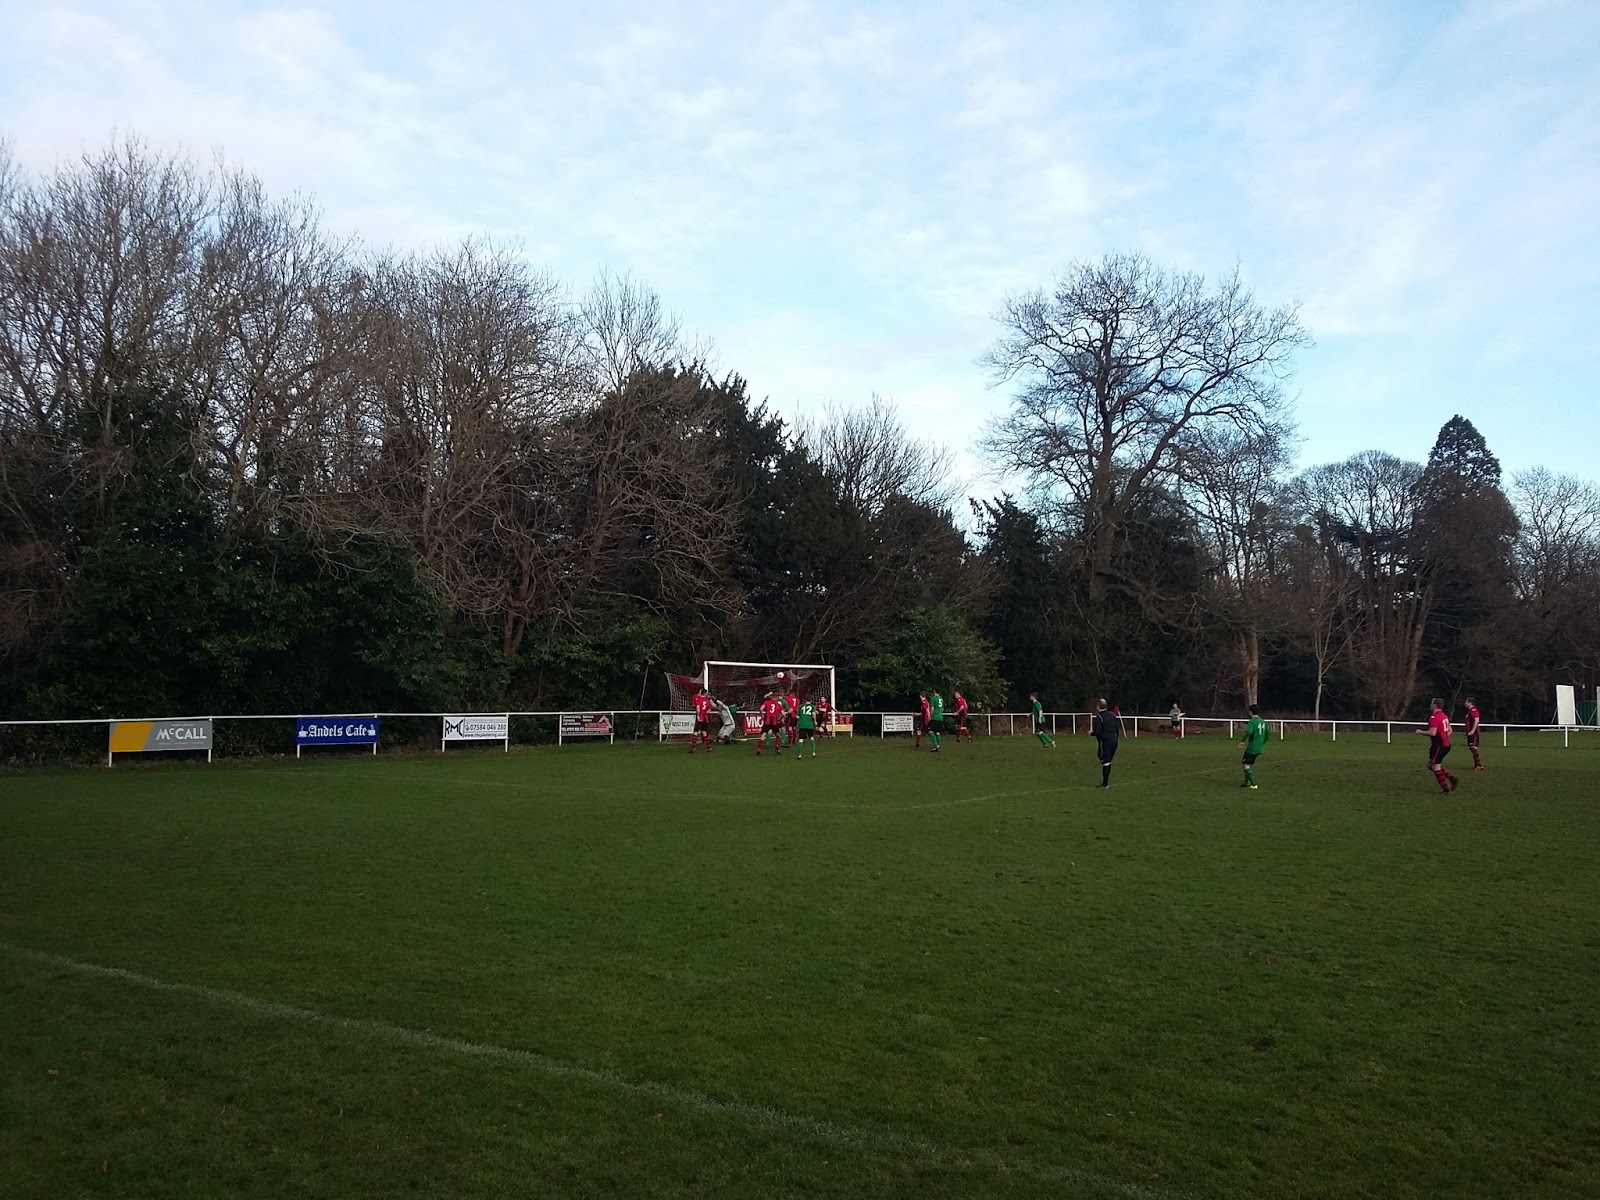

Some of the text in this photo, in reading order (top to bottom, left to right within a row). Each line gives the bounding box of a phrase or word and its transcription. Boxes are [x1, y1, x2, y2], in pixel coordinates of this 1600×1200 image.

[702, 701, 707, 710] 5
[769, 703, 776, 714] 3
[938, 698, 943, 708] 5
[801, 705, 813, 716] 12
[308, 724, 368, 738] Andels Cafe
[444, 719, 464, 738] RMC
[1257, 722, 1265, 735] 11
